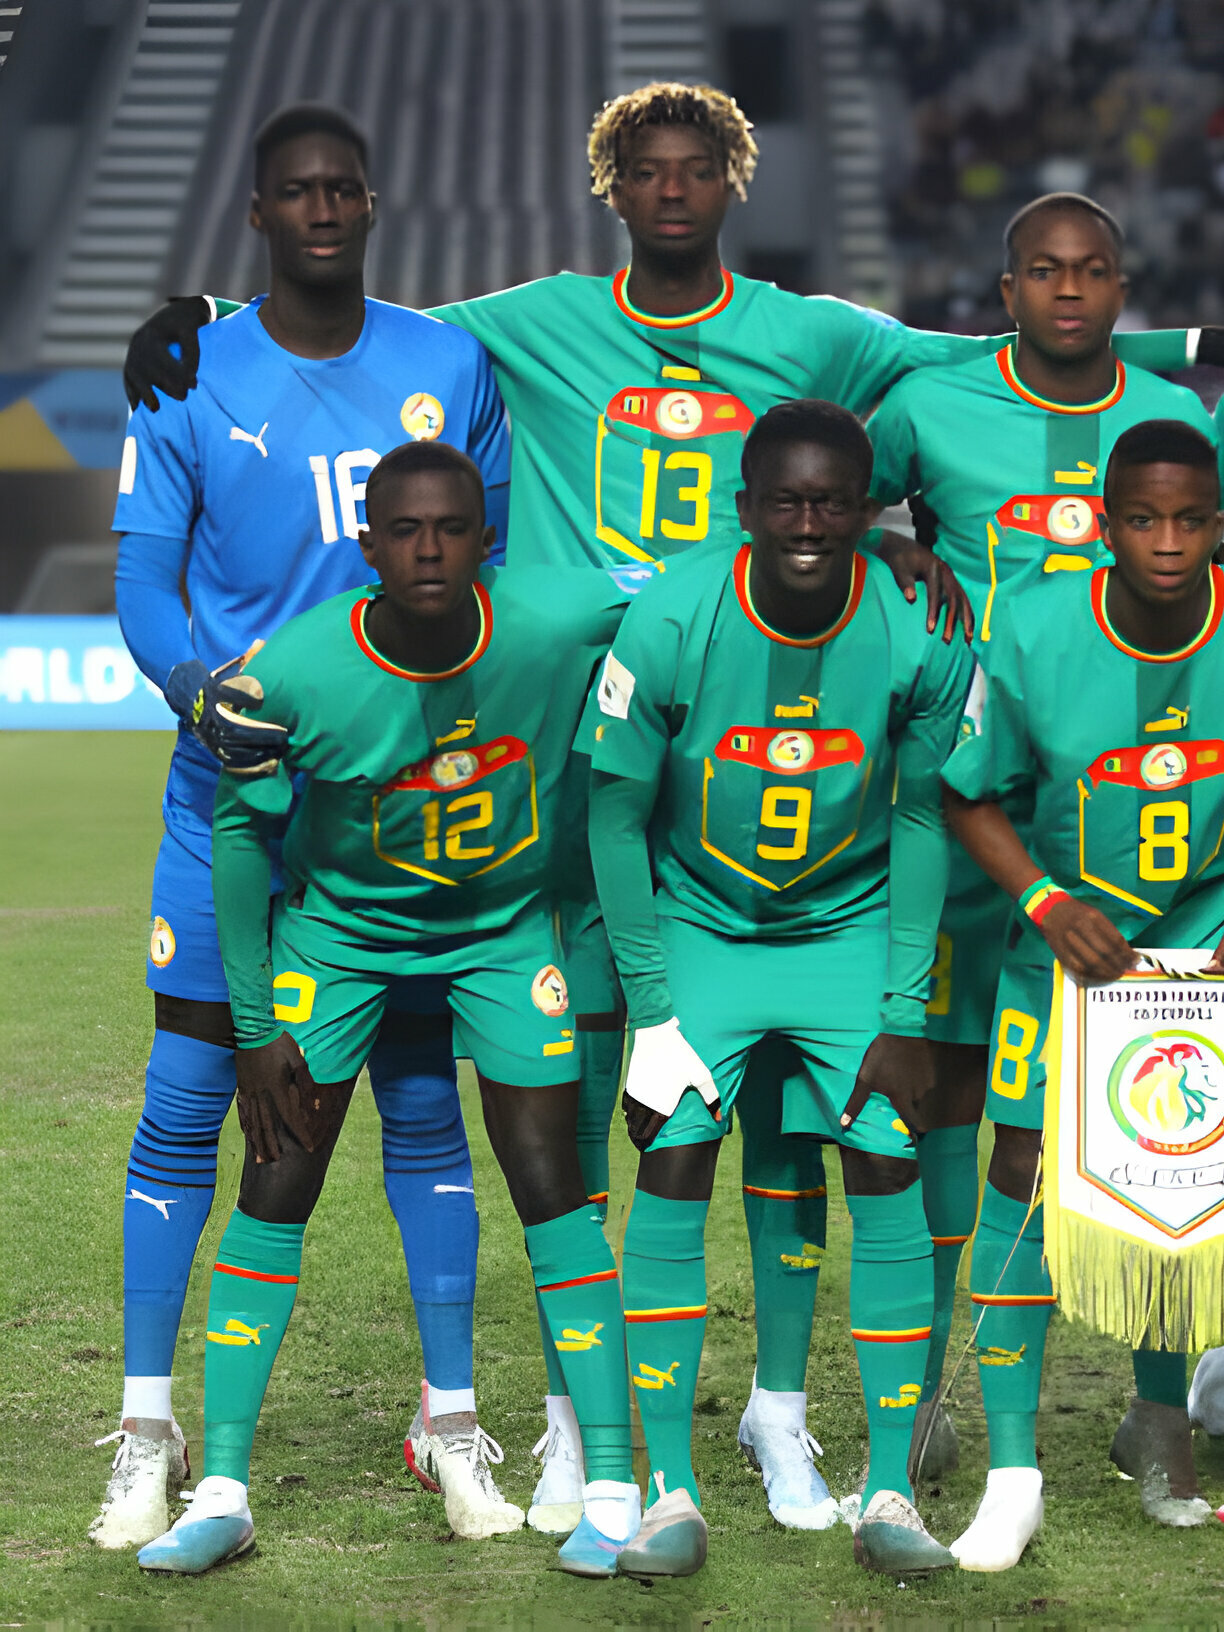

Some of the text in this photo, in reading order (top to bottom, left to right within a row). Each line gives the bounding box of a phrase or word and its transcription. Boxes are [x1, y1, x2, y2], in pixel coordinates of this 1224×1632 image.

[639, 449, 712, 541] 13
[420, 790, 495, 861] 12
[756, 785, 812, 861] 9
[1138, 800, 1190, 882] 8
[991, 1008, 1039, 1100] 8
